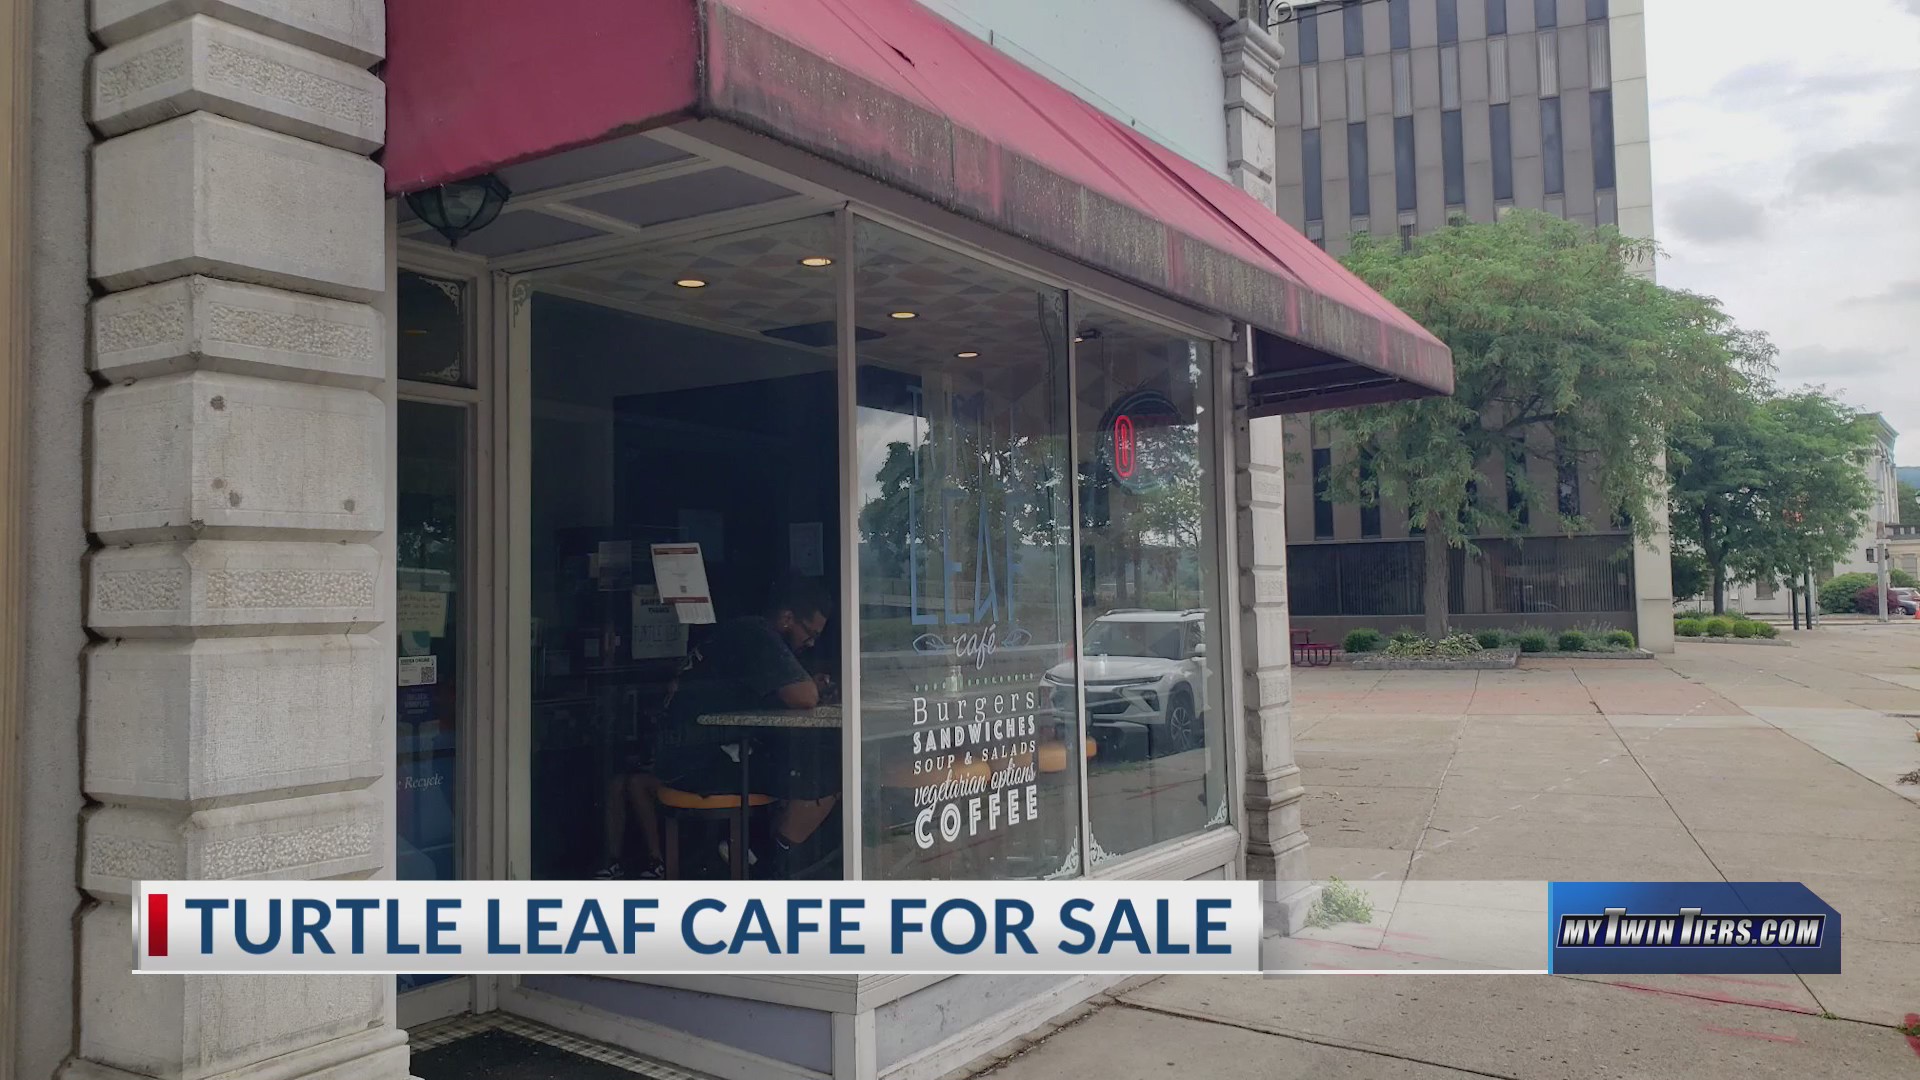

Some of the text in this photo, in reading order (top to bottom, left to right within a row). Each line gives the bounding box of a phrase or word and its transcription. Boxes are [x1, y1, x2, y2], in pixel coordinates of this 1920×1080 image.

[909, 484, 1032, 625] LEAF
[953, 624, 996, 670] café
[913, 691, 1034, 725] Burgers
[913, 715, 1035, 754] SANDWICHES
[914, 740, 1036, 774] SOUP & SALADS
[404, 773, 444, 791] Recycle
[914, 758, 1036, 811] vegetarian options
[914, 785, 1037, 849] COFFEE
